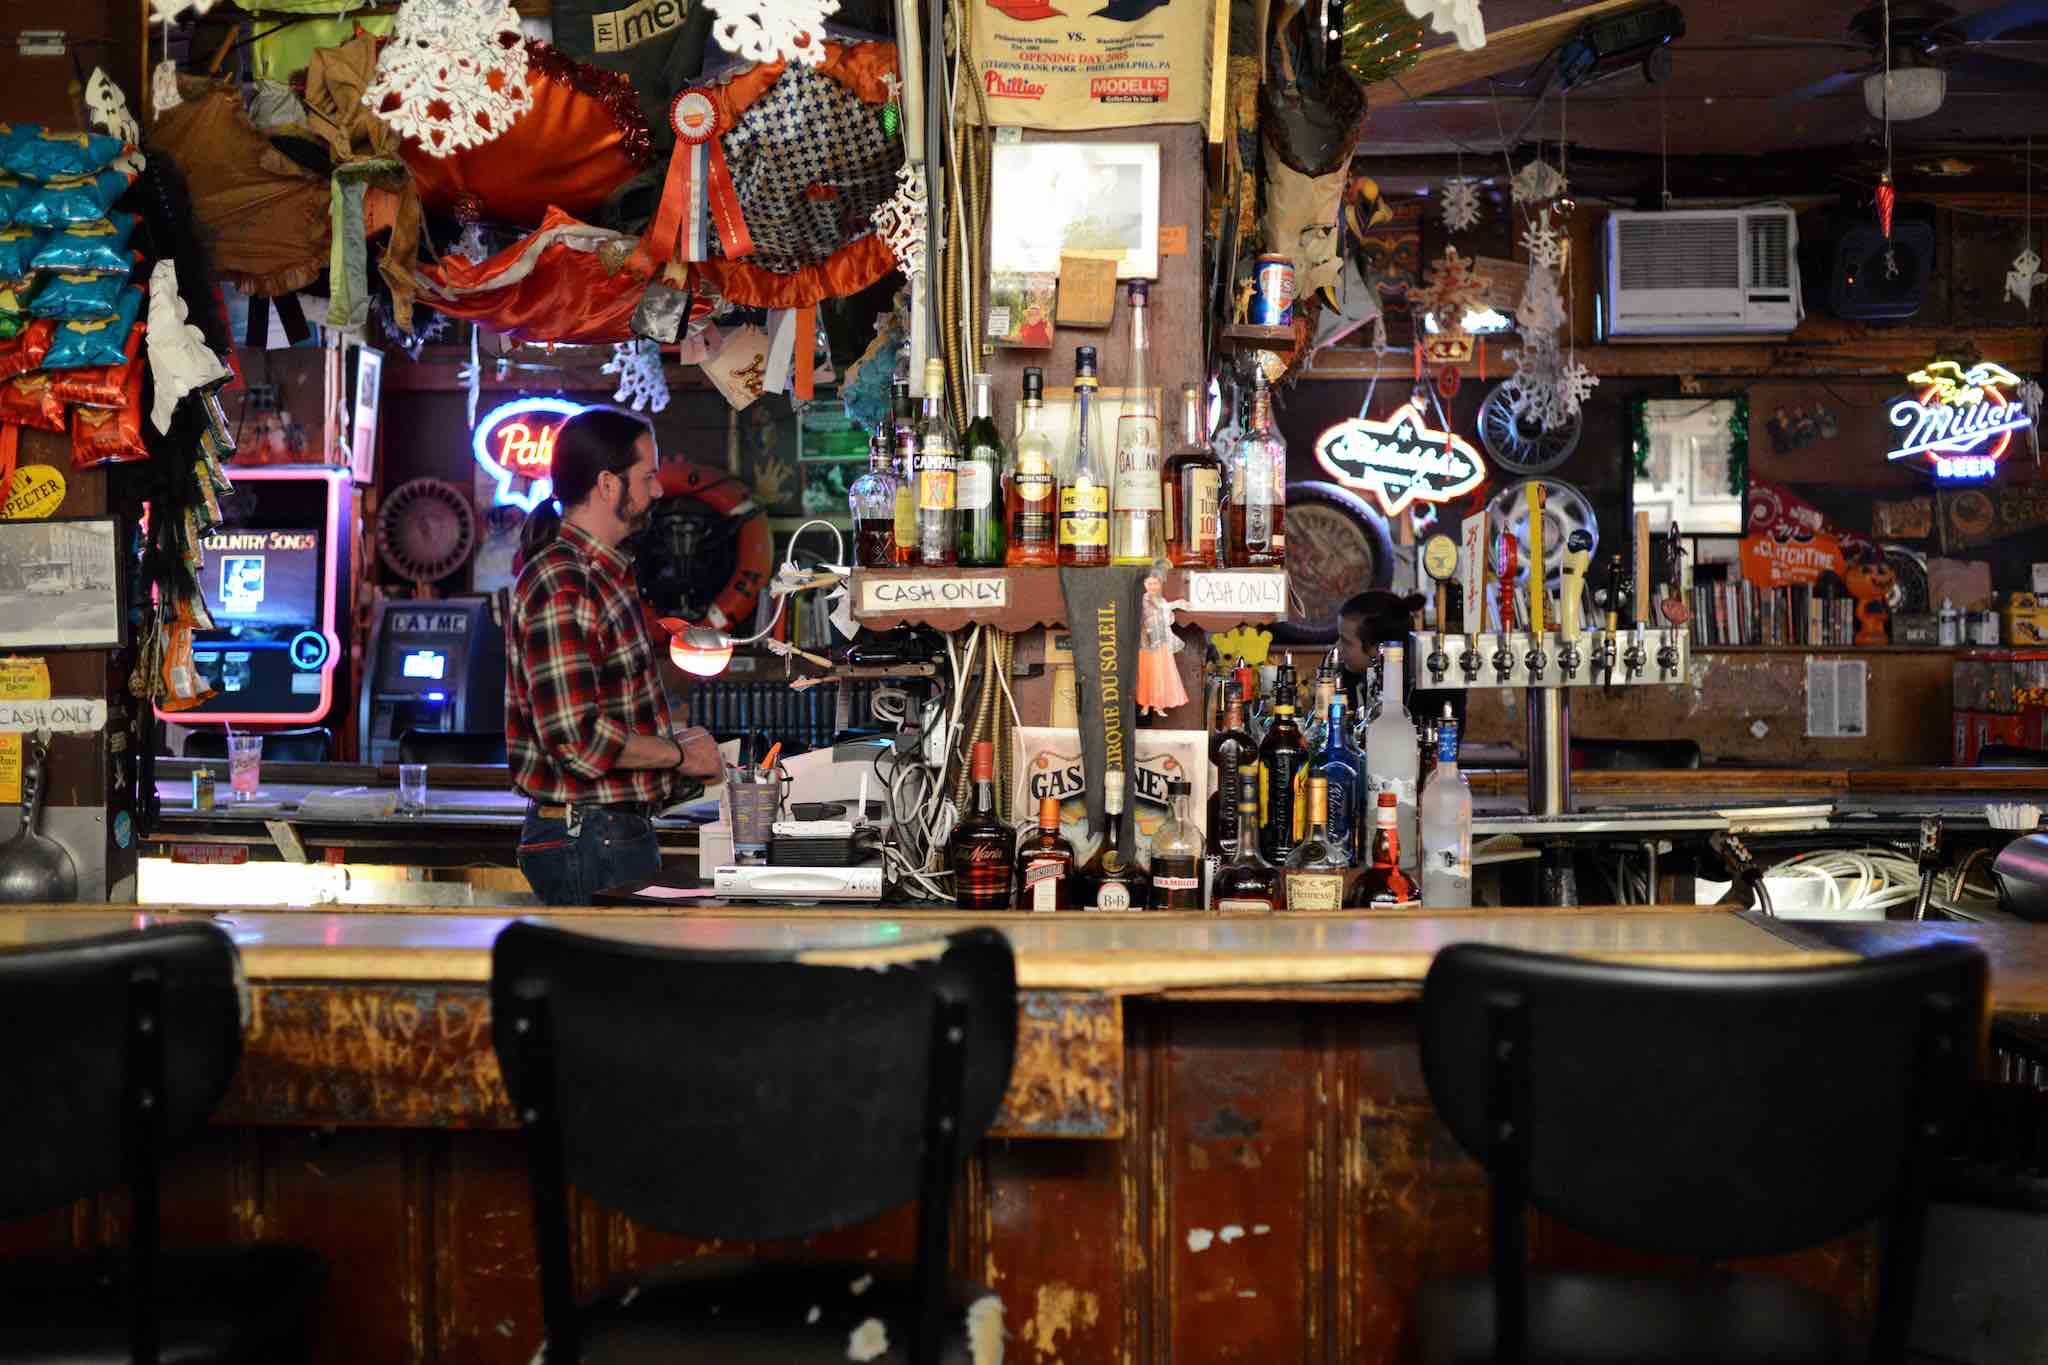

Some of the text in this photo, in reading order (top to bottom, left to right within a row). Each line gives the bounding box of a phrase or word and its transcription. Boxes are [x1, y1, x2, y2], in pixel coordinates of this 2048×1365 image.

[597, 22, 613, 43] TPI
[1019, 52, 1075, 65] OPENING
[1079, 53, 1101, 65] DAY
[1023, 63, 1048, 72] BANK
[1051, 64, 1077, 73] PARK
[1159, 61, 1171, 70] PA
[984, 69, 1047, 97] Phillies
[1092, 79, 1168, 94] MODELL'S
[1890, 400, 2024, 450] Miller
[1936, 458, 1996, 478] BEER
[204, 531, 315, 550] COUNTRY SONGS
[875, 580, 1001, 602] CASH ONLY
[1196, 576, 1281, 605] CASH ONLY
[1097, 600, 1119, 672] SOLEIL
[1101, 674, 1120, 704] DU
[51, 703, 95, 724] ONLY
[1031, 764, 1084, 800] GAS
